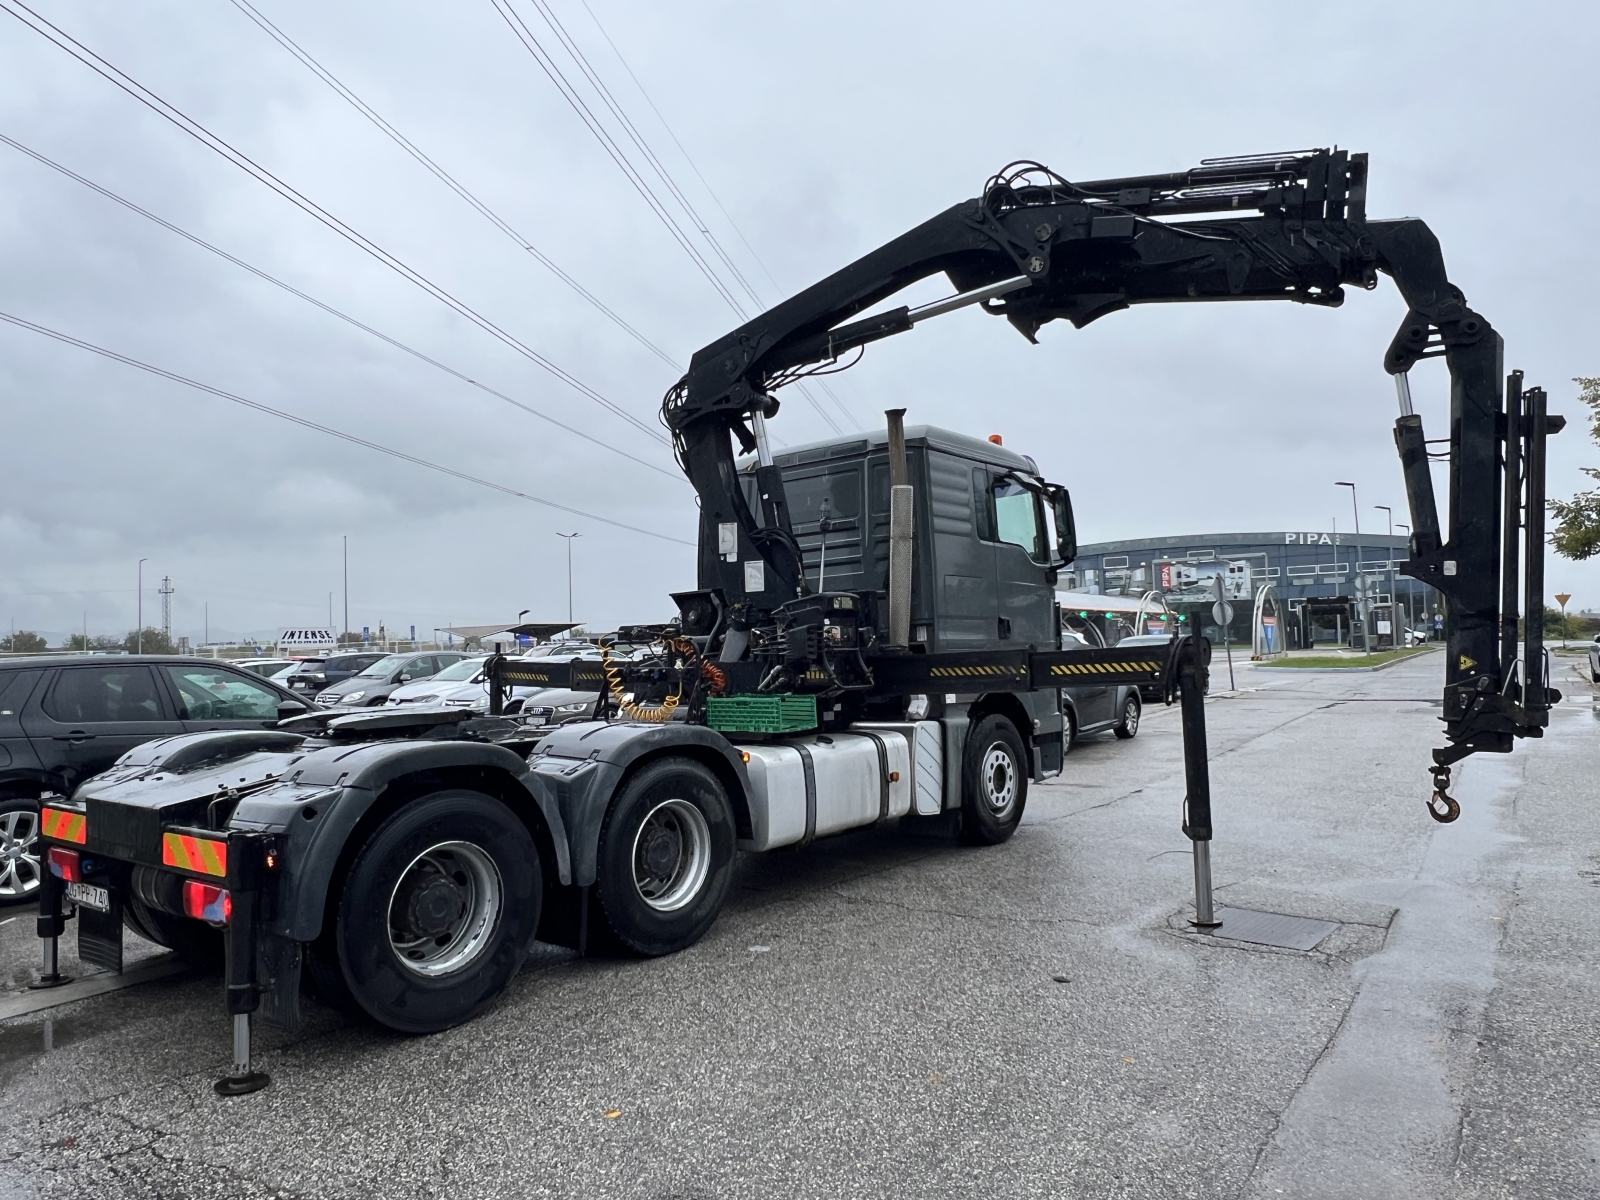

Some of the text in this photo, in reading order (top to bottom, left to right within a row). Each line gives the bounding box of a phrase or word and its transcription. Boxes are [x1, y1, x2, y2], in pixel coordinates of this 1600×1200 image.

[1285, 533, 1332, 545] PIPA
[1161, 566, 1170, 588] PIPA
[281, 630, 333, 640] INTENSE
